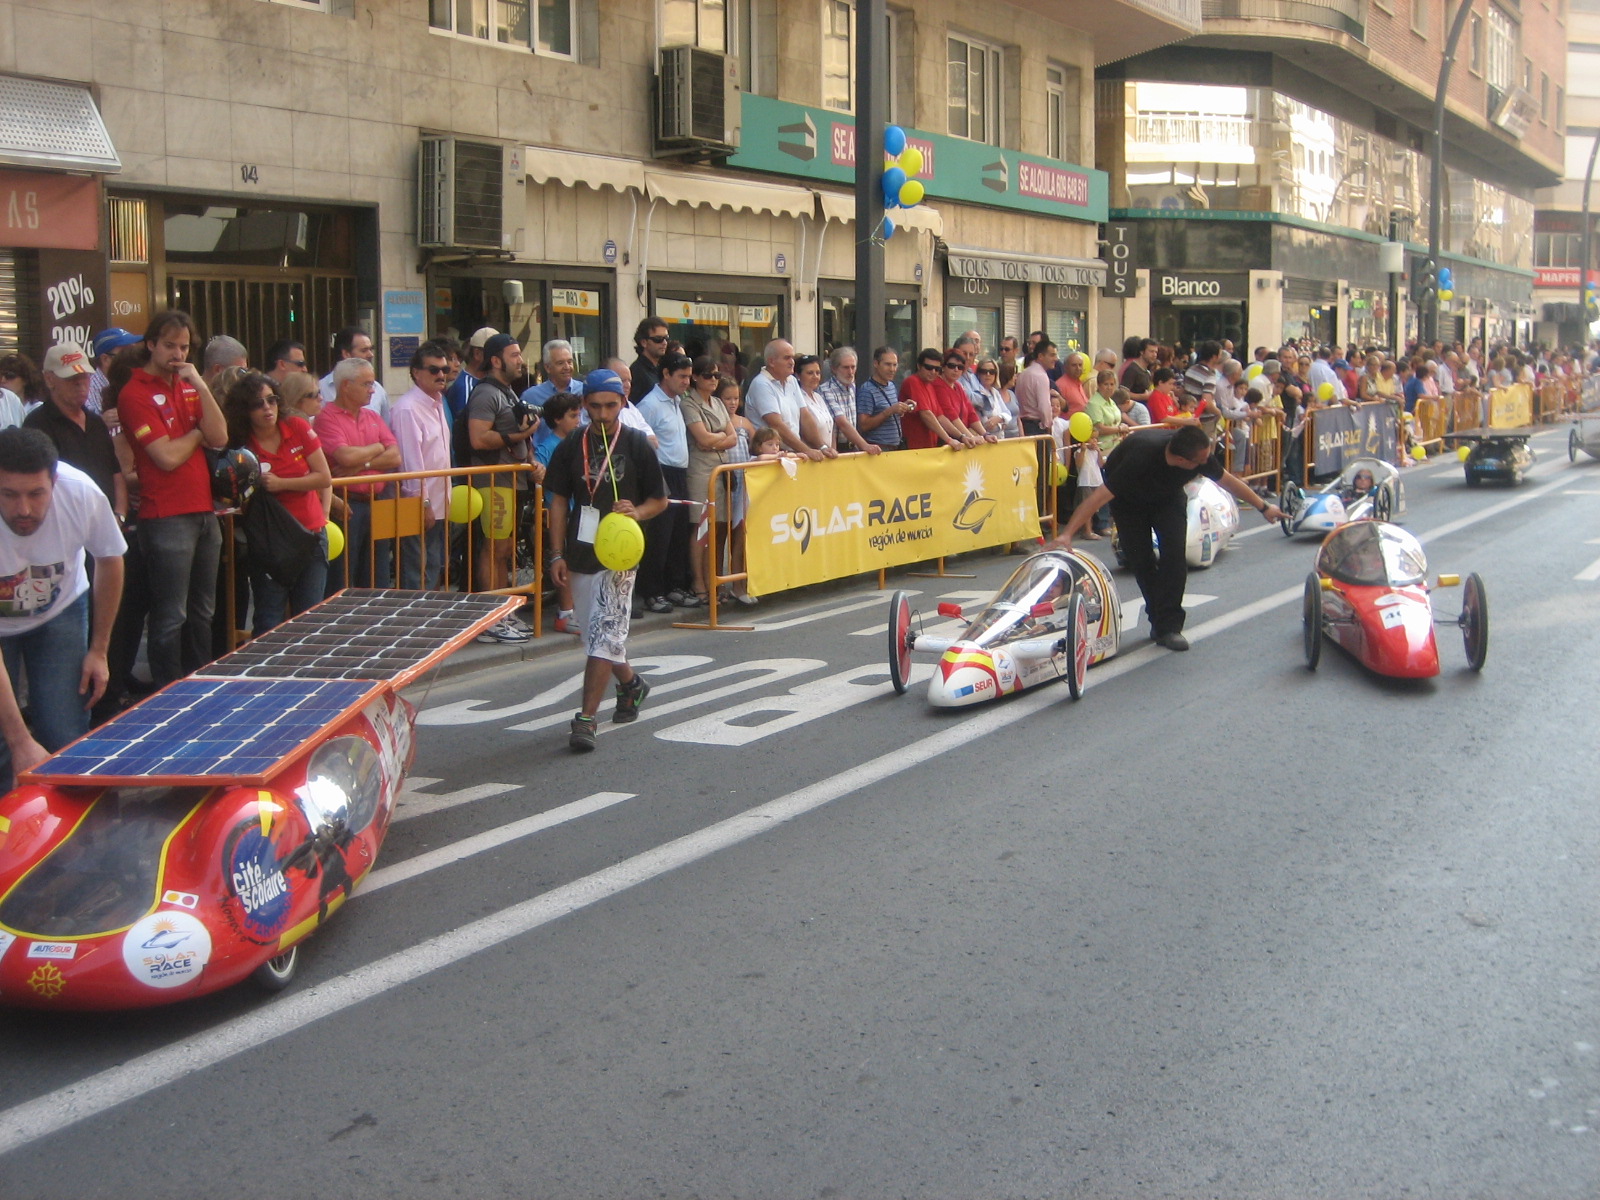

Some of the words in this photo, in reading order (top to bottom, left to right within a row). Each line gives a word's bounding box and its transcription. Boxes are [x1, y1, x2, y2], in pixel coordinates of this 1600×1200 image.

[240, 164, 259, 184] 14
[1020, 164, 1029, 191] SE
[1030, 167, 1056, 196] ALQUILA
[1112, 227, 1130, 293] TOUS
[959, 258, 989, 277] TOUS
[1001, 261, 1029, 280] TOUS
[1040, 265, 1065, 283] TOUS
[1075, 268, 1100, 285] TOUS
[963, 278, 989, 295] TOUS
[1057, 285, 1080, 300] TOUS
[1162, 276, 1221, 296] Blanco
[47, 273, 95, 320] 20%
[770, 502, 864, 554] SOLAR
[868, 492, 932, 526] RACE
[868, 528, 895, 551] región
[895, 528, 906, 543] de
[907, 526, 933, 541] murcia
[975, 679, 993, 692] SEUR
[233, 855, 262, 893] cité
[33, 944, 72, 955] AUTOSUR
[142, 950, 198, 967] SOLAR
[150, 958, 192, 973] RACE
